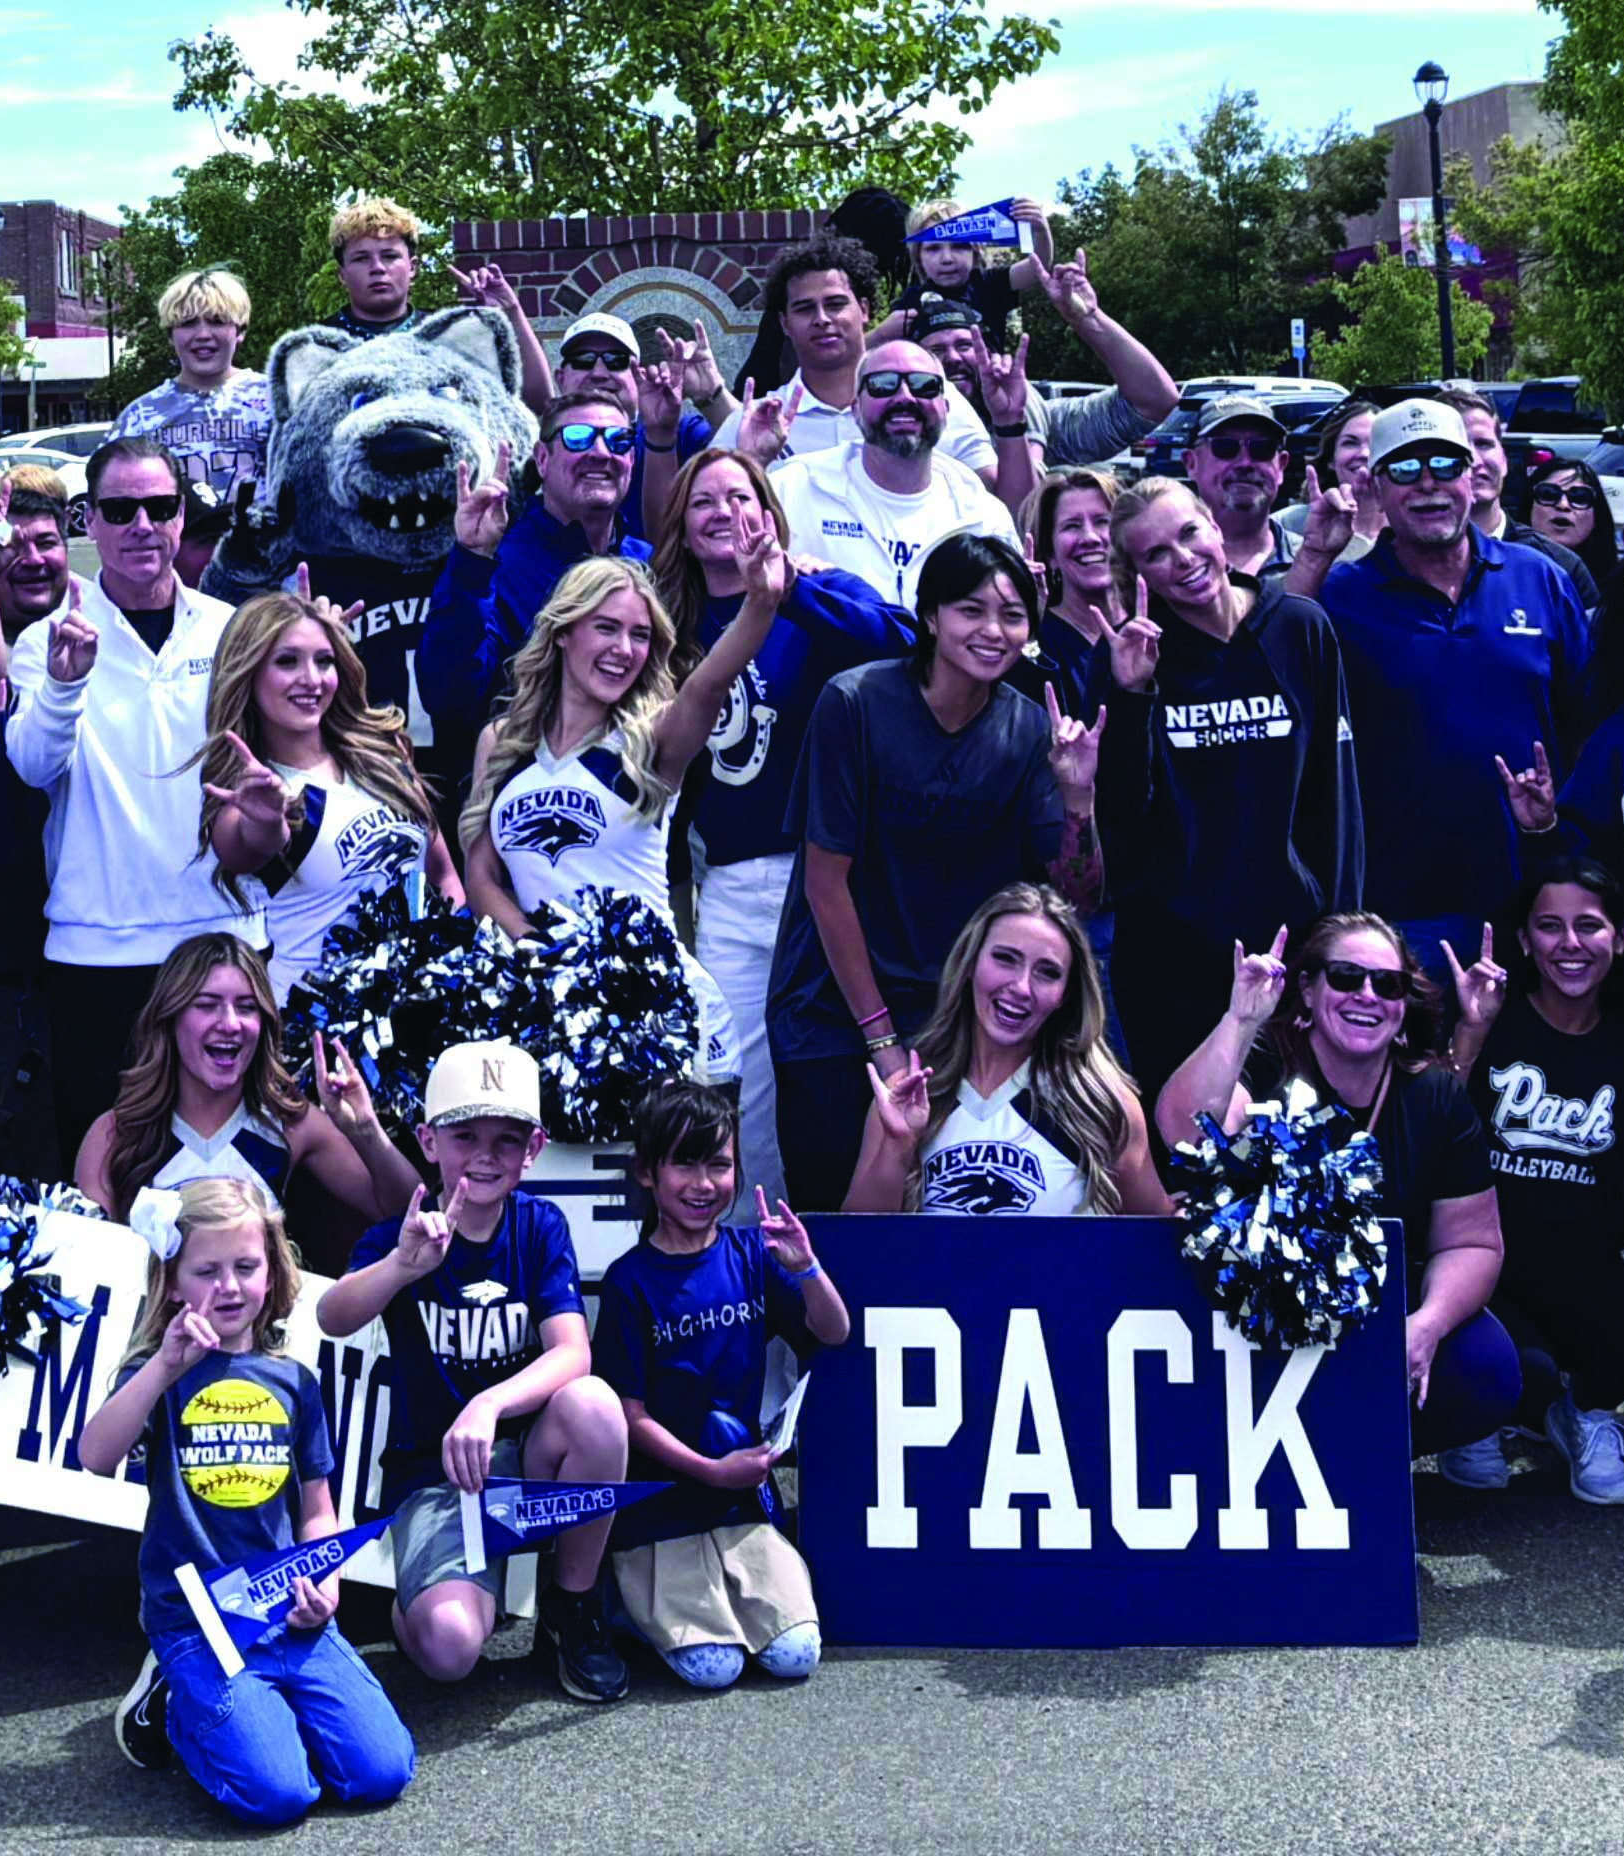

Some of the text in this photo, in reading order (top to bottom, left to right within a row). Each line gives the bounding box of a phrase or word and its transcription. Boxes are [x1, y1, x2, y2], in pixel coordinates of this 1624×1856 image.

[821, 520, 864, 532] NEVADA
[1165, 694, 1289, 728] NEVADA
[1196, 724, 1267, 747] SOCCER
[501, 789, 601, 828] NEVADA
[481, 1059, 505, 1092] N
[1489, 1061, 1616, 1157] Pack
[926, 1144, 1041, 1184] NEVADA
[191, 1423, 273, 1443] NEVADA
[864, 1306, 1350, 1550] PACK
[179, 1445, 290, 1465] WOLF PACK
[514, 1487, 616, 1520] NEVADA'S
